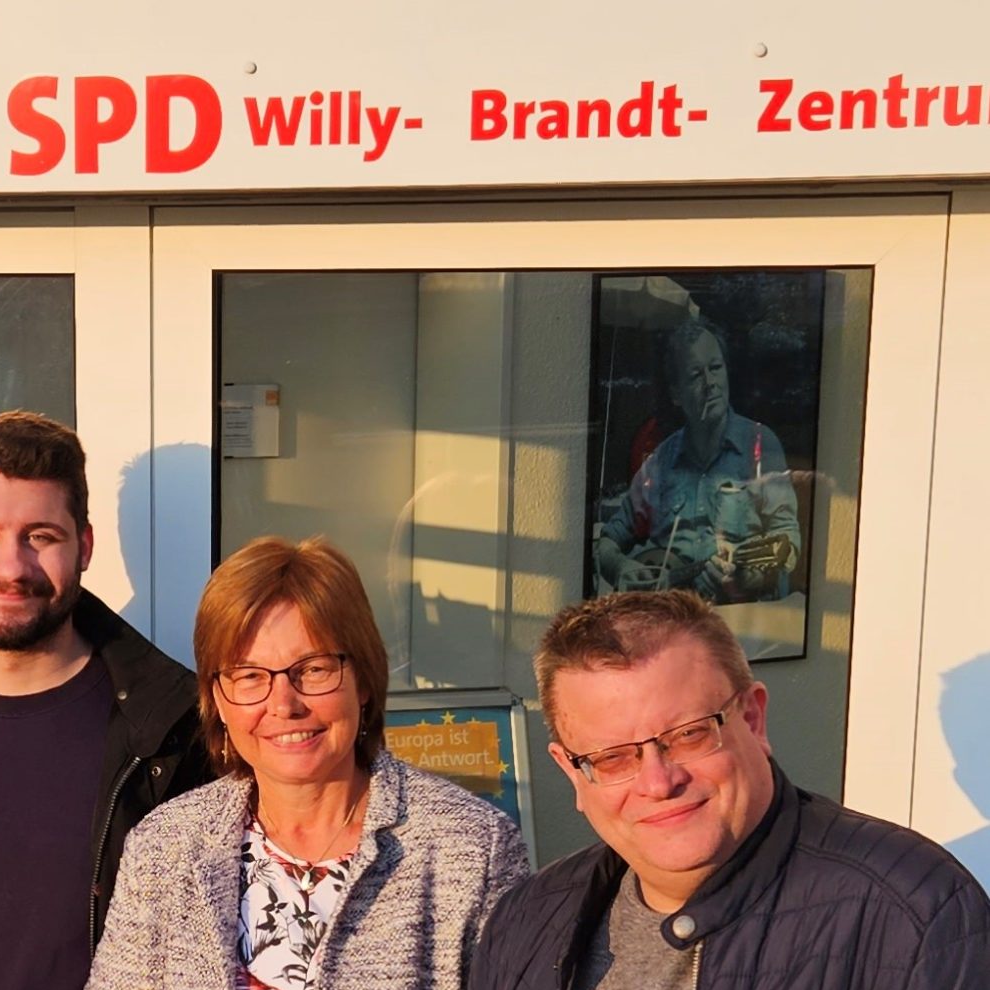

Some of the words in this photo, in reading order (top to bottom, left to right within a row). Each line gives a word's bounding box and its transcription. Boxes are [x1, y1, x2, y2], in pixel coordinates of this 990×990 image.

[7, 73, 223, 177] SPD
[243, 90, 424, 163] Willy-
[469, 80, 708, 142] Brandt-
[756, 74, 990, 133] Zentru
[385, 732, 444, 752] Europa
[449, 728, 470, 746] ist
[417, 749, 494, 768] Antwort.
